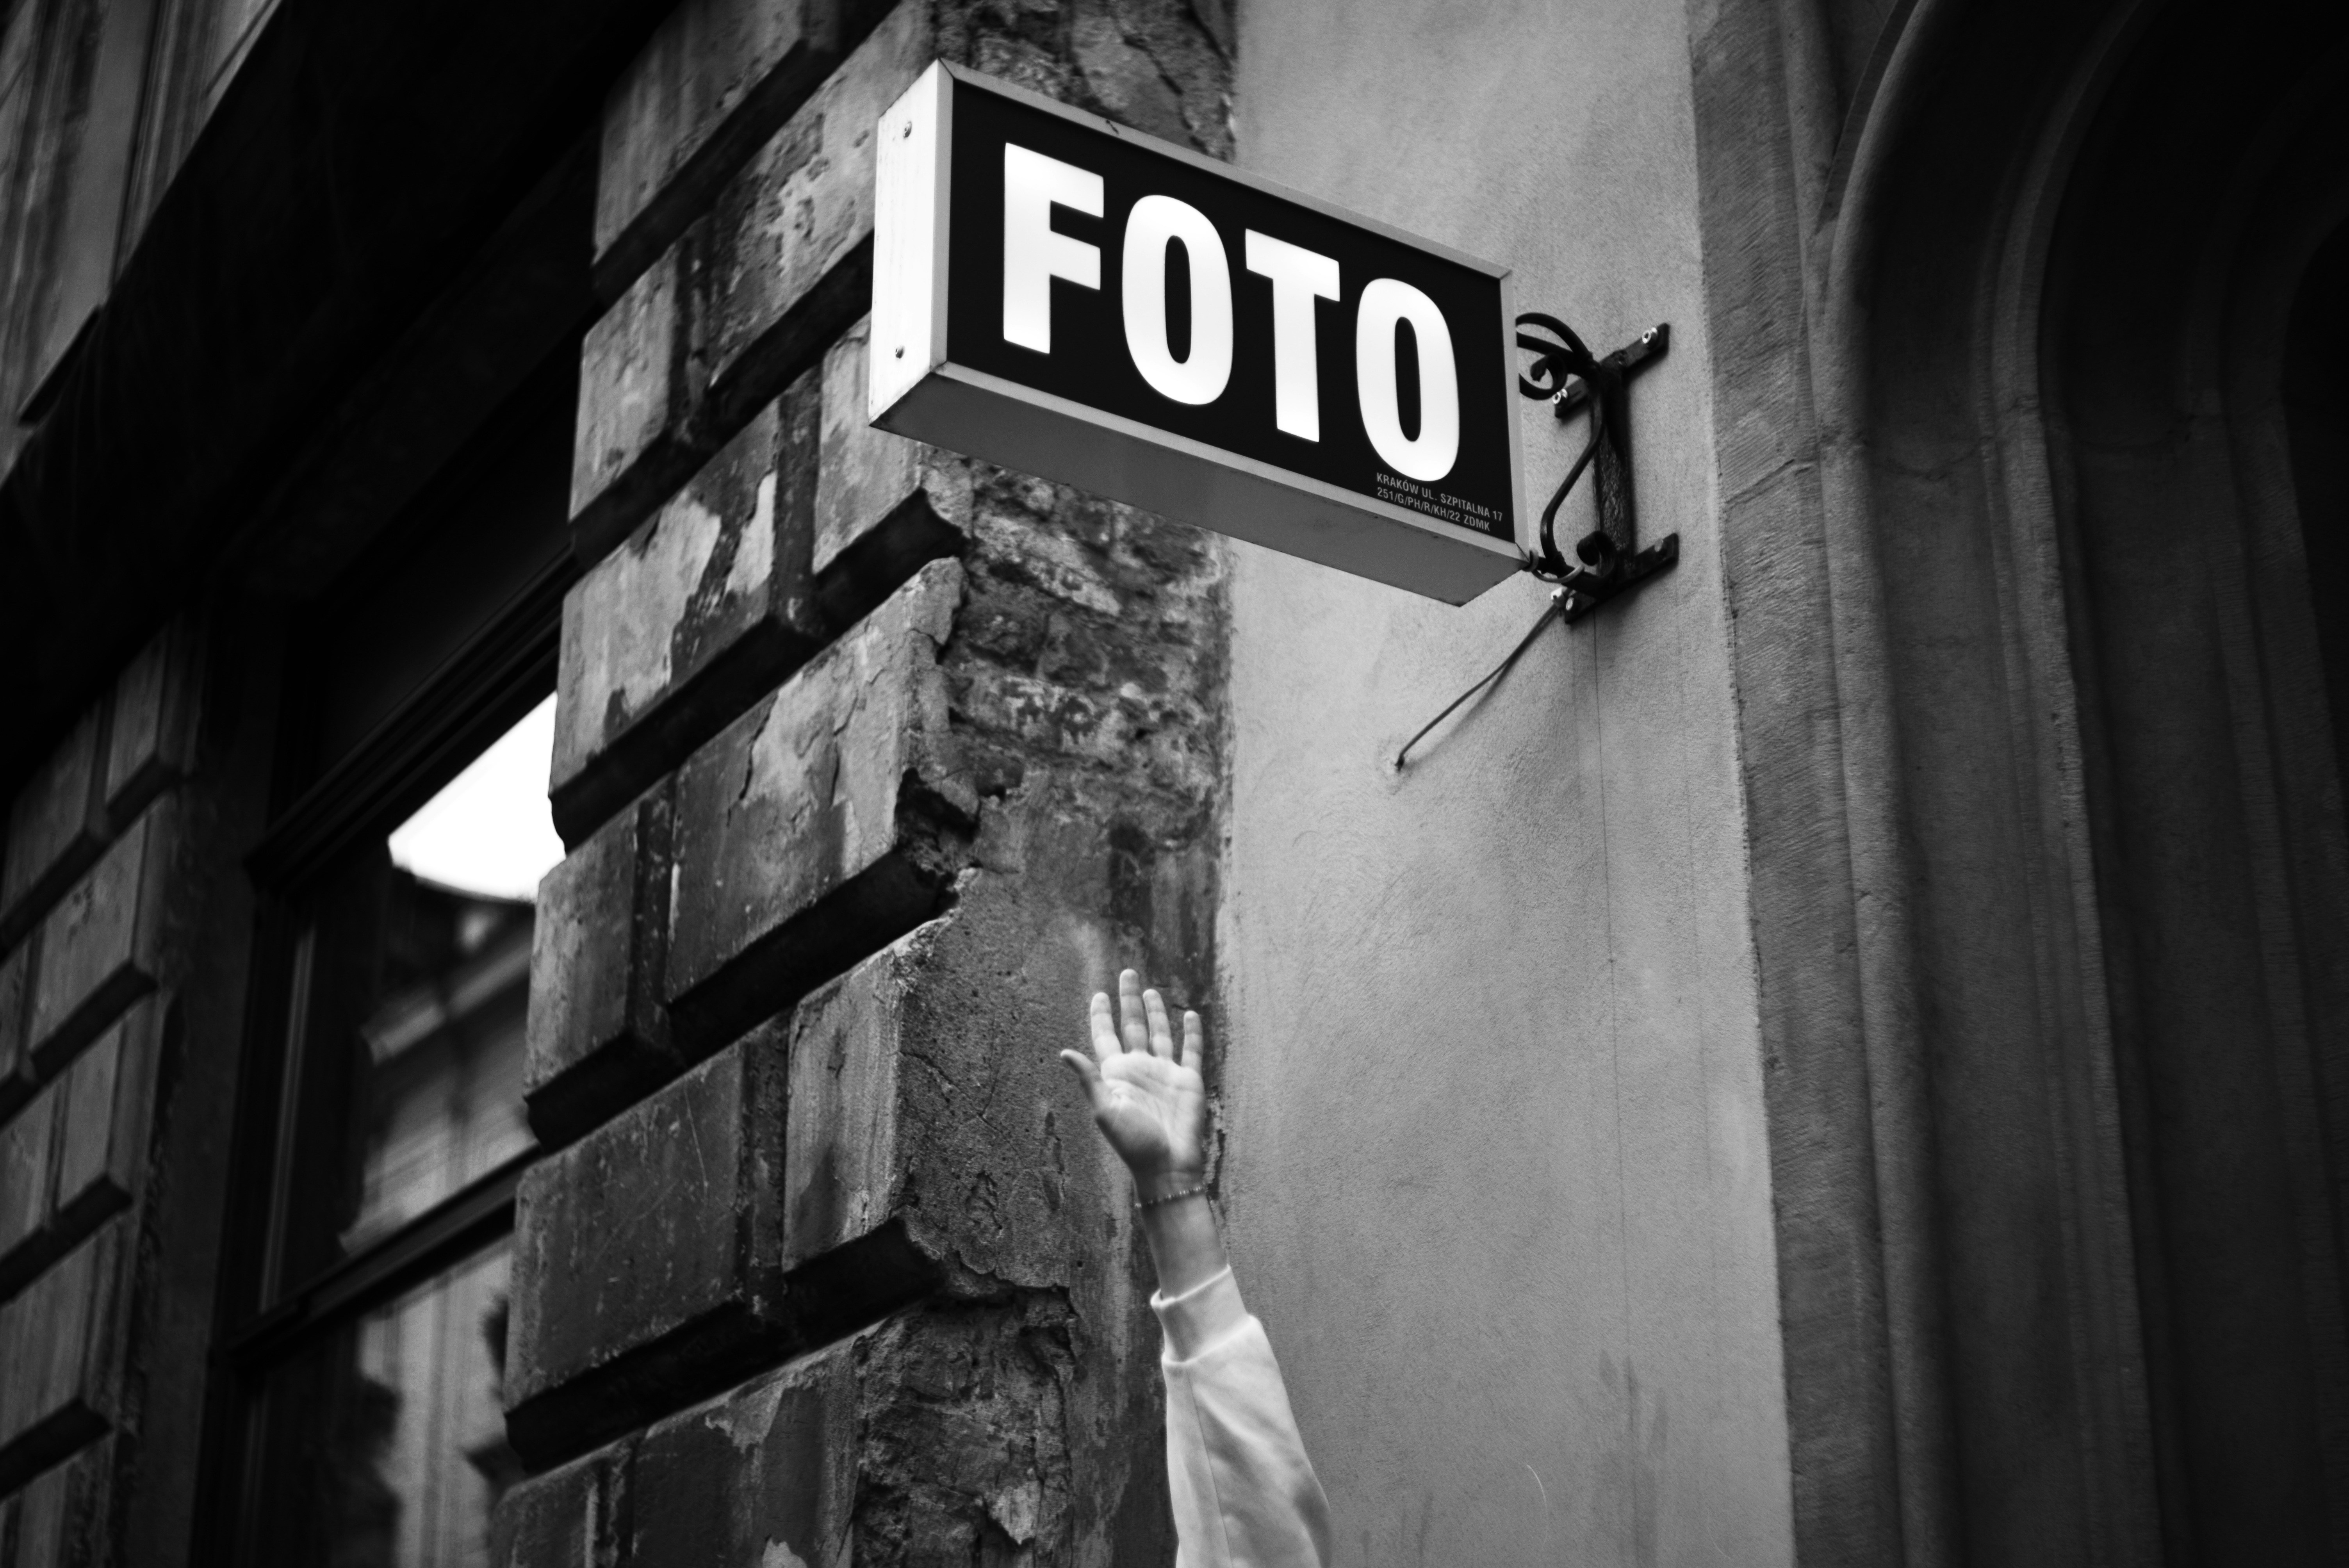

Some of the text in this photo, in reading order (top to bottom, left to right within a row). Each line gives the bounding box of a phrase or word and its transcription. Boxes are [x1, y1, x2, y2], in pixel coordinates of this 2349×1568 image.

[1003, 142, 1460, 481] FOTO
[1377, 472, 1502, 521] KRAKÓW UL. SZPITALNA 17
[1378, 487, 1490, 531] 251/G/PH/R/KH/22 ZDMK
